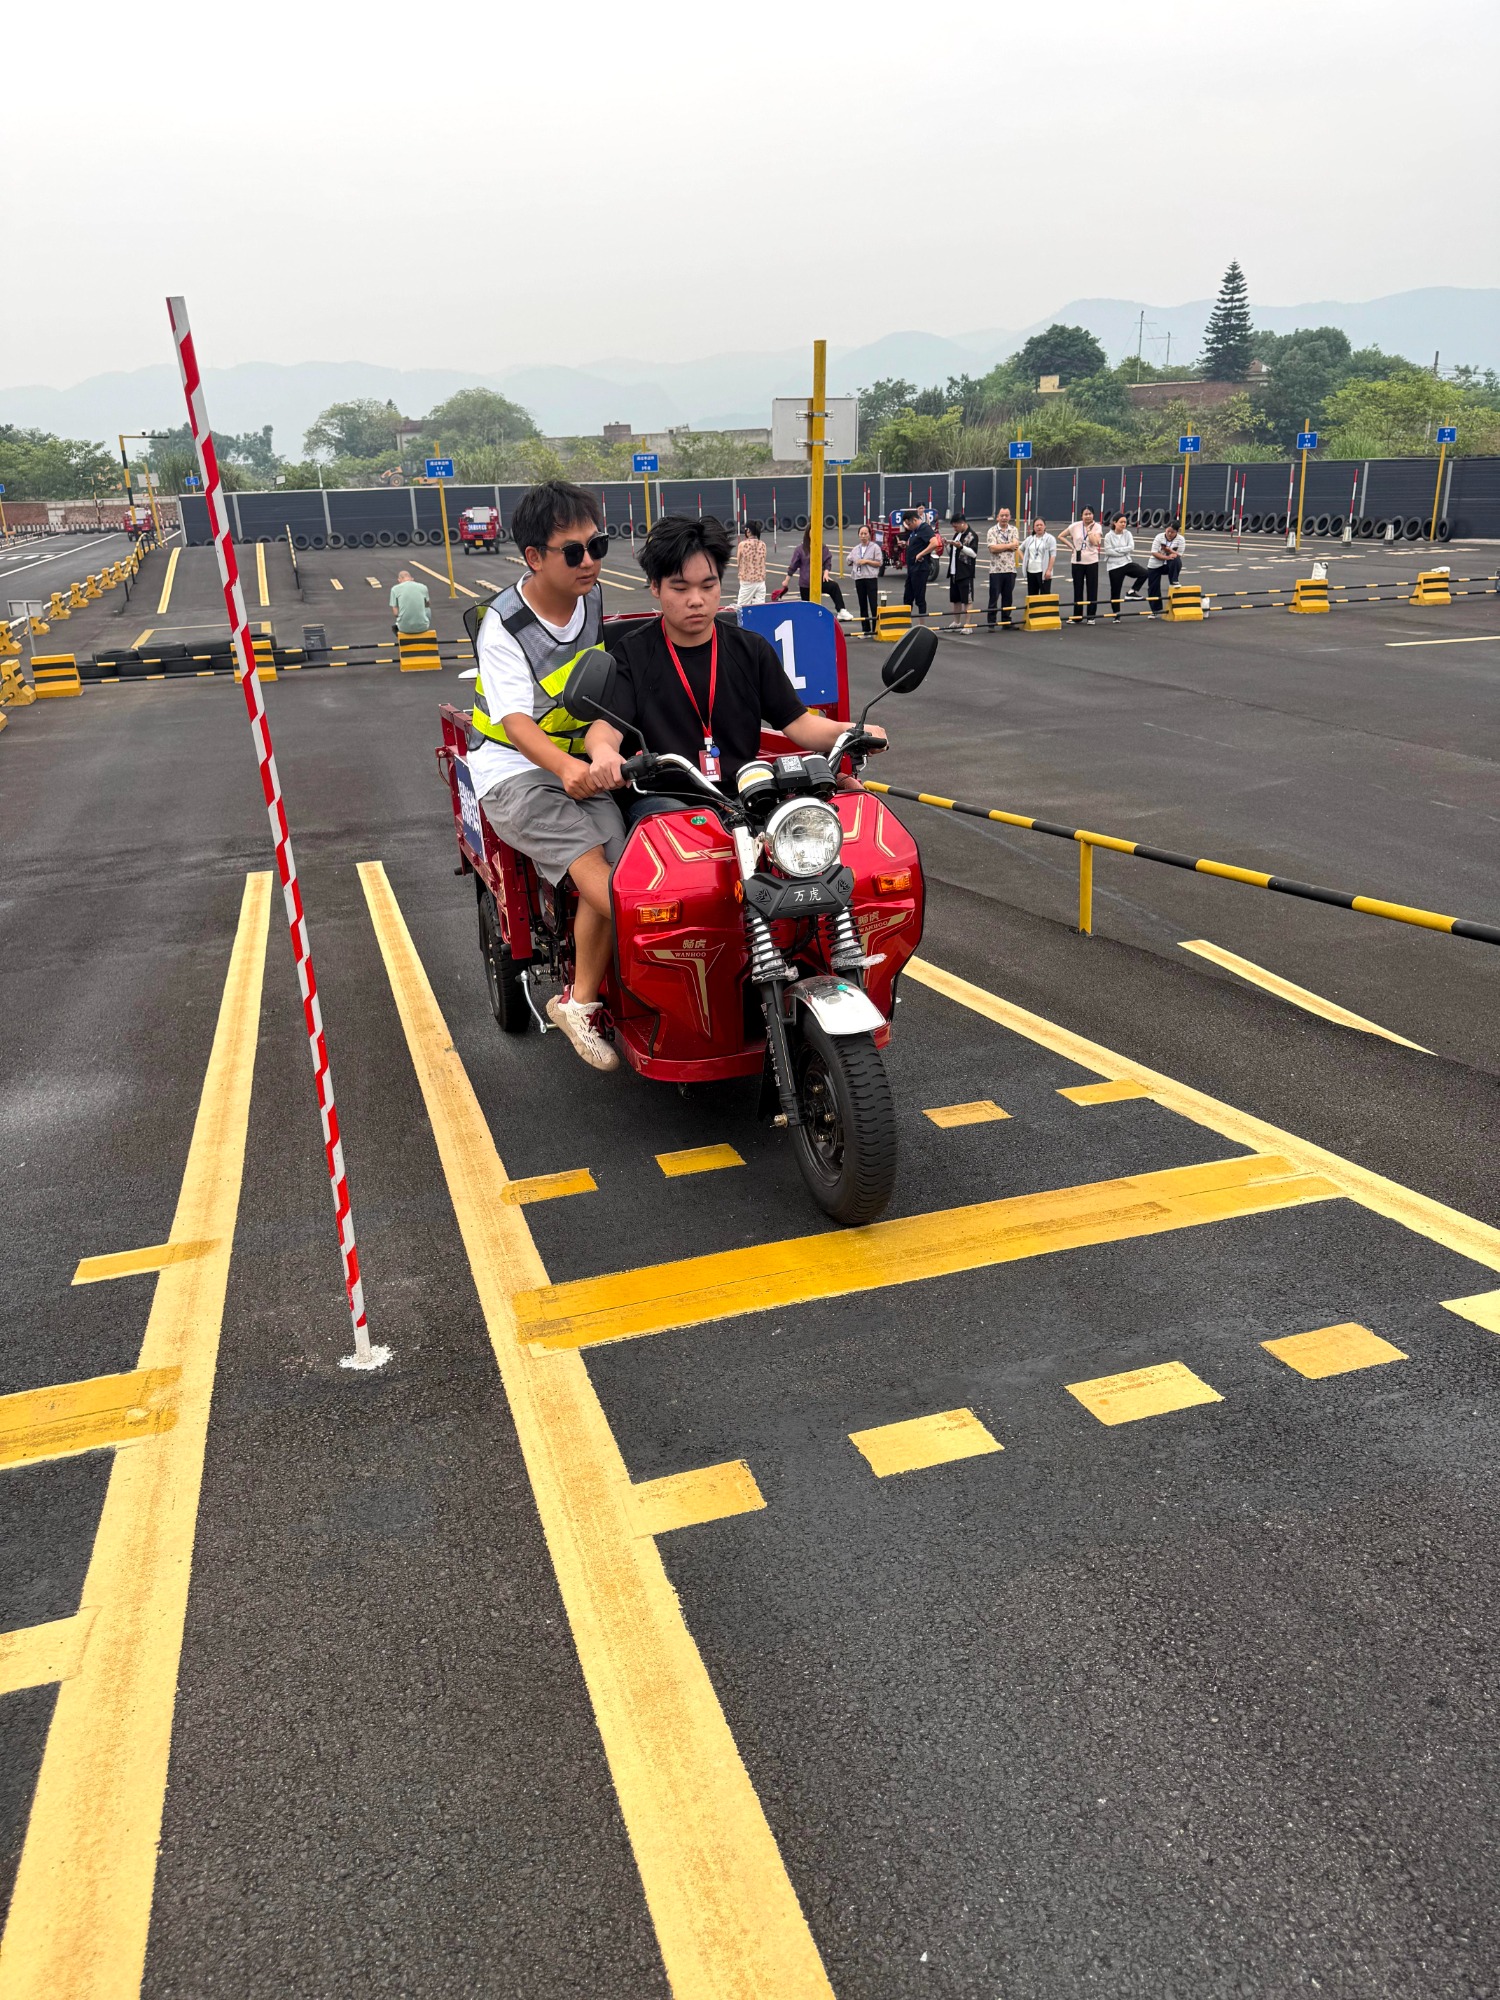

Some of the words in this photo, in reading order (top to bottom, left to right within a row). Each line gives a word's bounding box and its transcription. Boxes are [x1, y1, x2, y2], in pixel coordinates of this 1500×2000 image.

[895, 512, 902, 524] 5
[774, 619, 807, 690] 1
[793, 886, 822, 902] 万虎
[857, 920, 889, 933] WANHOO
